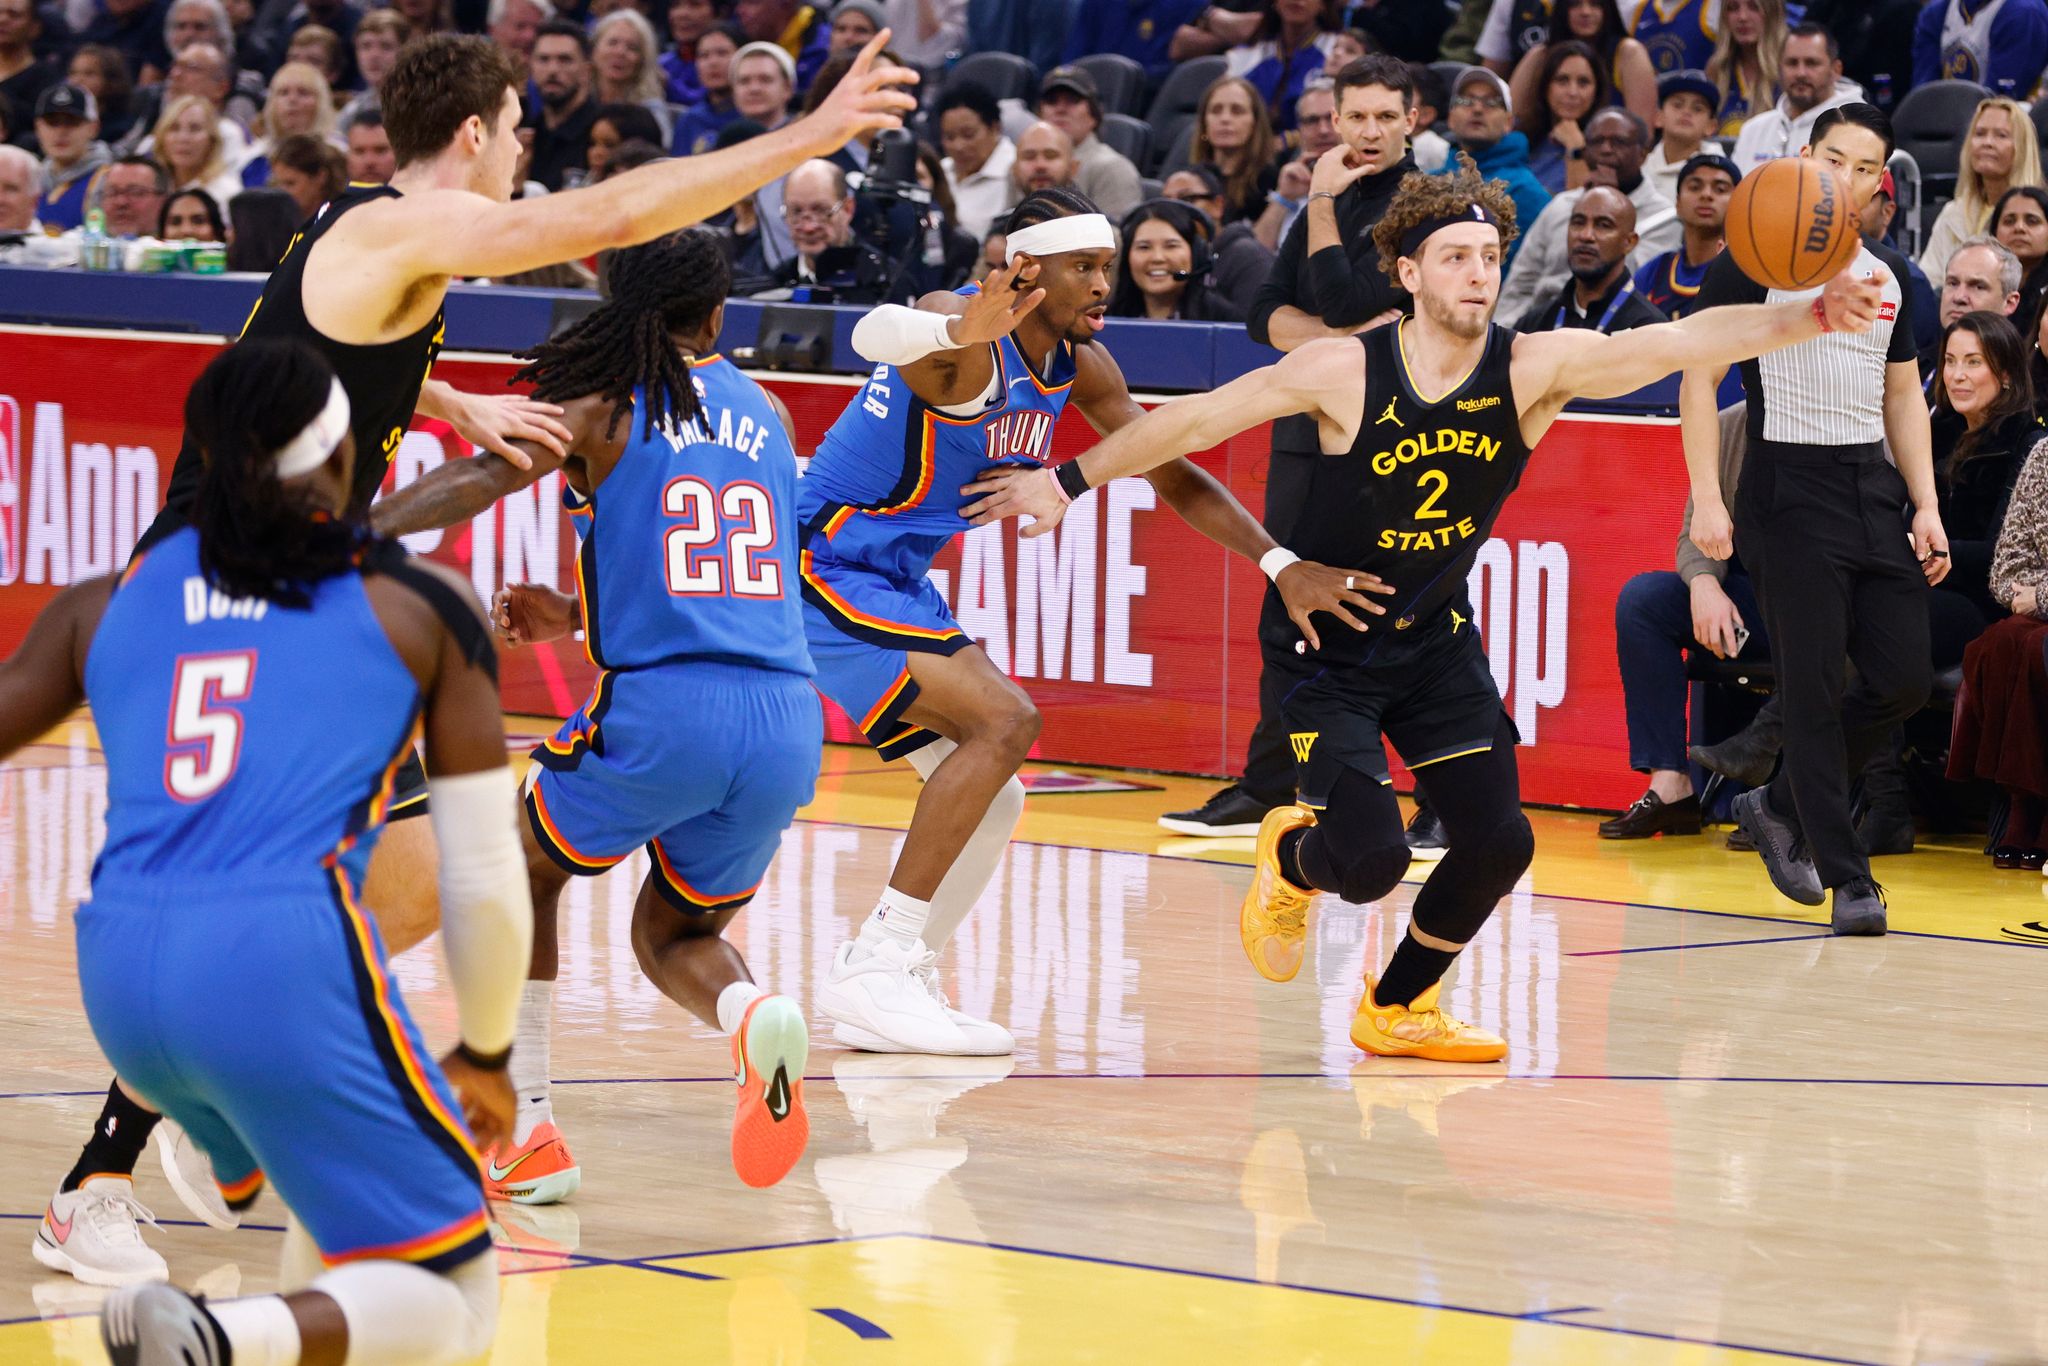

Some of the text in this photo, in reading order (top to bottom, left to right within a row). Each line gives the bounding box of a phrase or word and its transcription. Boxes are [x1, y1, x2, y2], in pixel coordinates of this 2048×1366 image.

[1804, 171, 1834, 254] Wilson
[1456, 396, 1500, 412] Rakuten
[984, 410, 1052, 461] THUN
[1371, 428, 1502, 476] GOLDEN
[1414, 469, 1449, 520] 2
[661, 474, 784, 600] 22
[1377, 516, 1477, 551] STATE
[925, 477, 1157, 687] AME
[163, 648, 259, 805] 5
